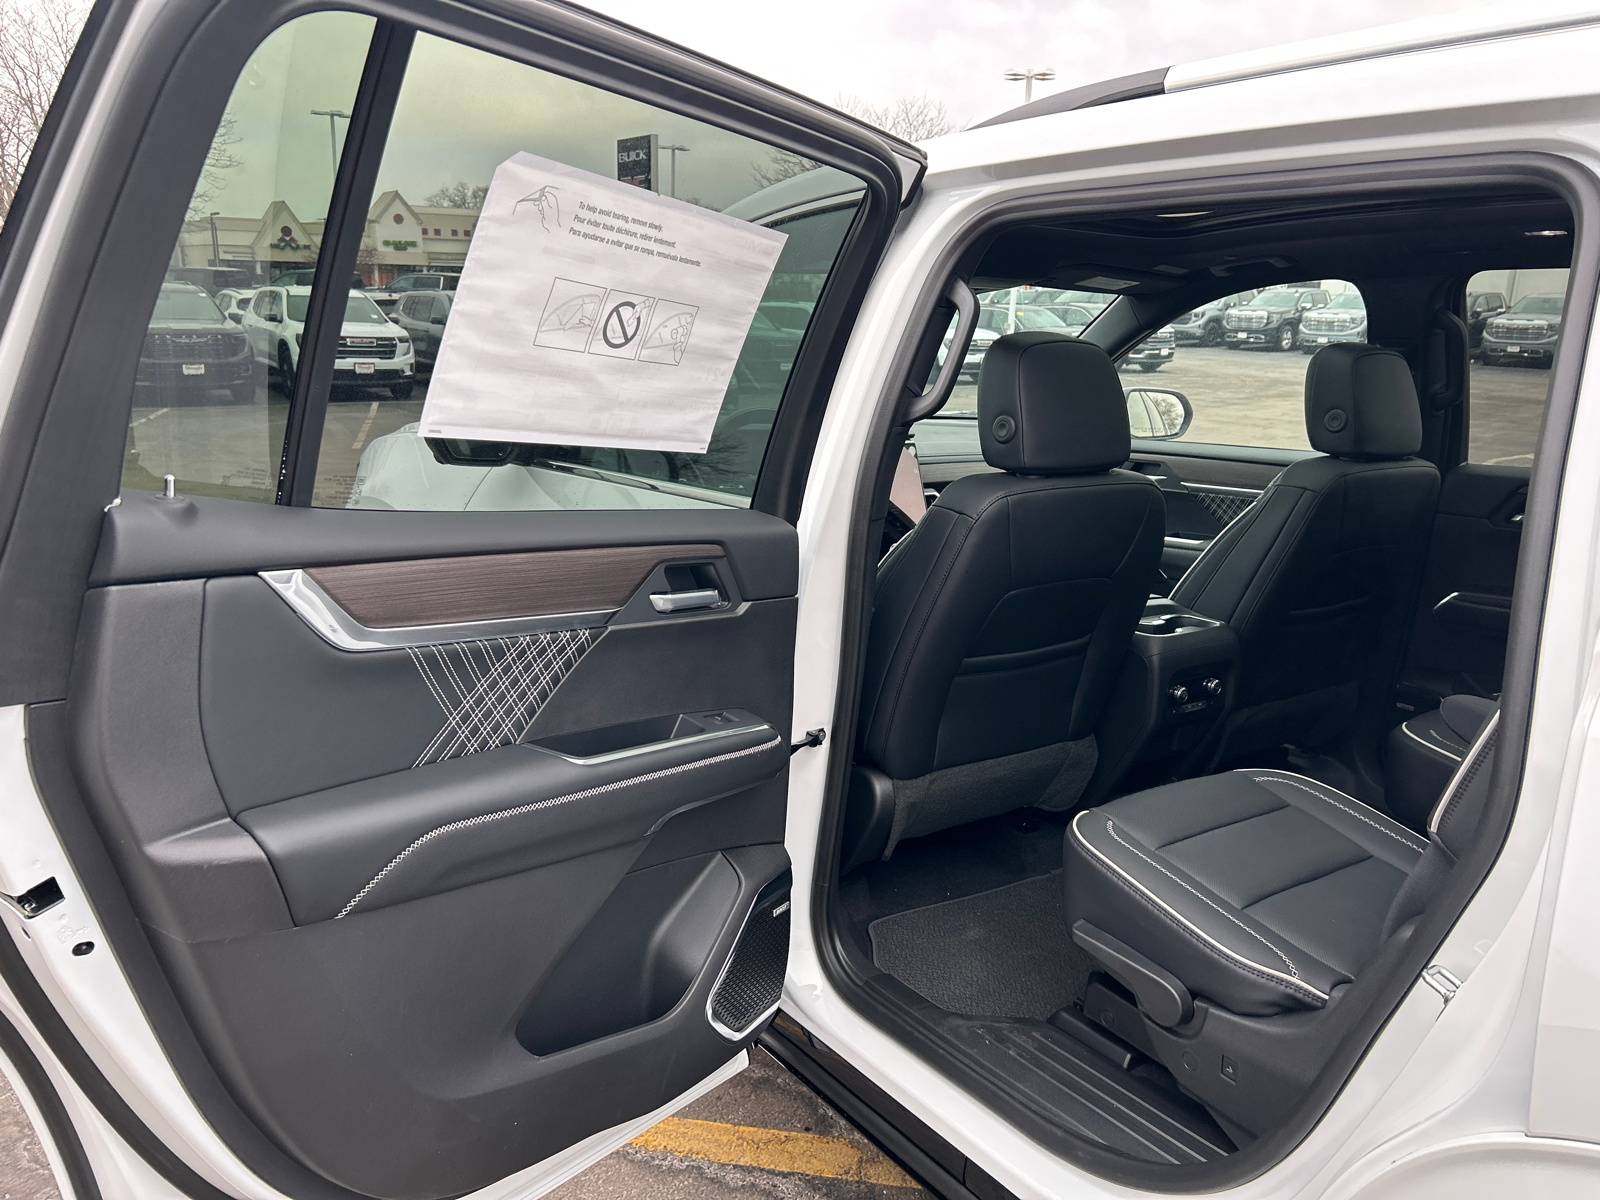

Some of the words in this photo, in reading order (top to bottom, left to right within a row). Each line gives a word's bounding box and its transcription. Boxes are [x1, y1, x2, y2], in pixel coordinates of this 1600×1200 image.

[618, 149, 647, 163] BUICK
[573, 214, 586, 224] Pour
[586, 217, 602, 228] éviter
[602, 222, 616, 232] toute
[615, 226, 639, 240] déchirure,
[639, 233, 654, 243] retirer
[579, 201, 586, 210] To
[586, 203, 598, 214] help
[598, 208, 612, 218] avoid
[612, 211, 629, 224] tearing,
[630, 217, 648, 228] remove
[647, 221, 664, 233] slowly.
[569, 226, 582, 237] Para
[582, 231, 606, 243] ayudarse
[610, 239, 625, 248] evitar
[624, 242, 634, 251] que
